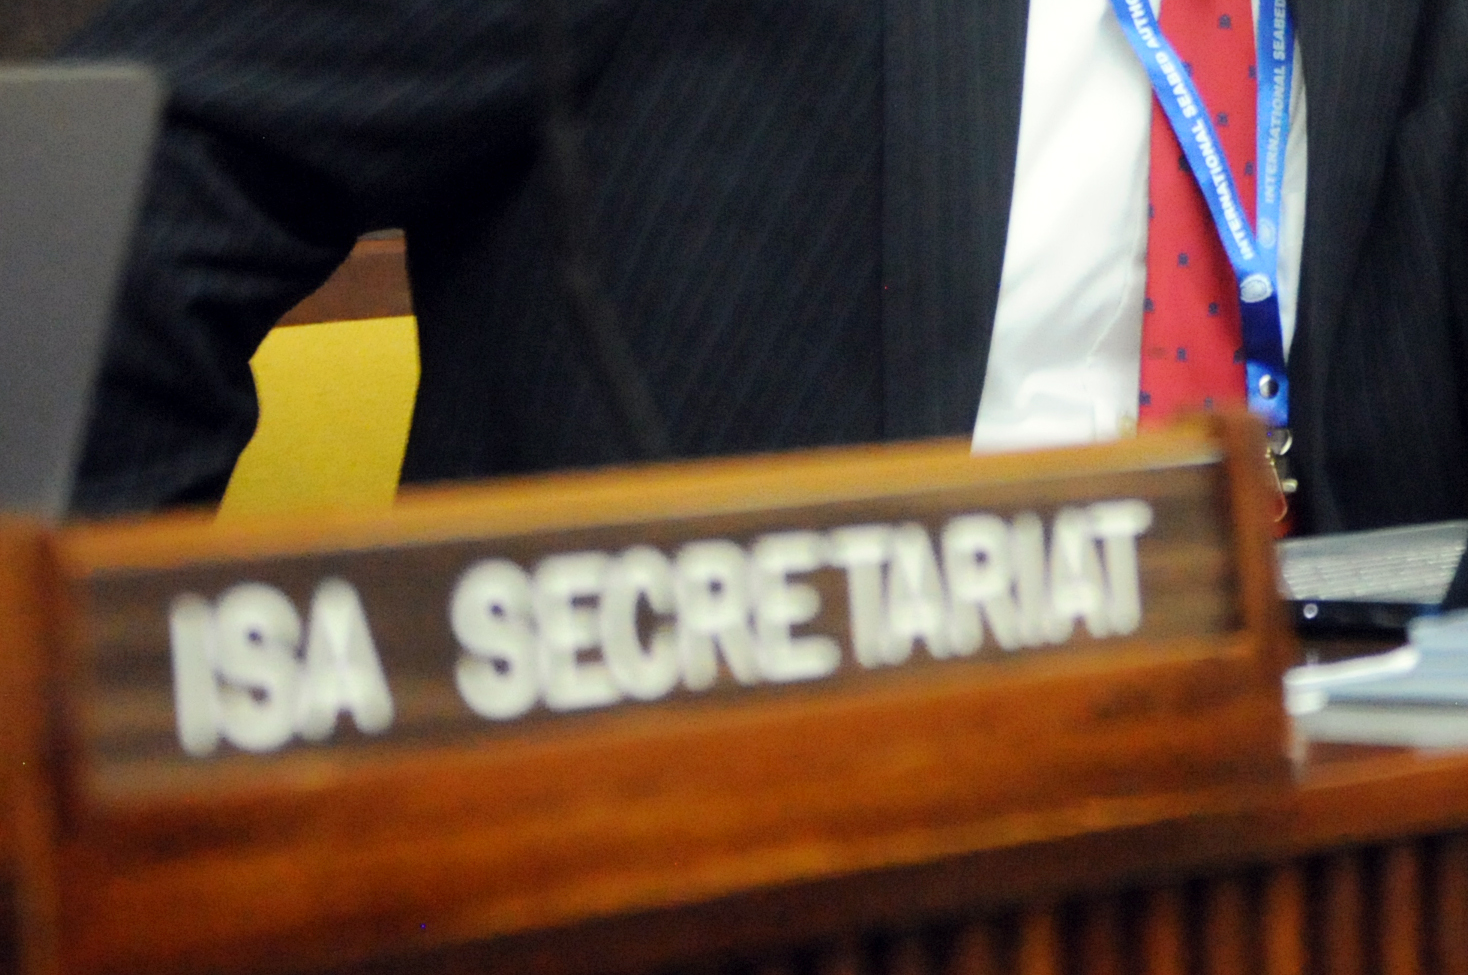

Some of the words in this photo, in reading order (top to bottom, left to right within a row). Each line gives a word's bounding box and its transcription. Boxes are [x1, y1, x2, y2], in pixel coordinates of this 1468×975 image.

[1155, 51, 1198, 118] SEABED
[1264, 65, 1286, 204] INTERNATIONAL
[1191, 118, 1255, 261] INTERNATIONAL
[170, 577, 393, 755] ISA
[450, 500, 1151, 719] SECRETARIAT
